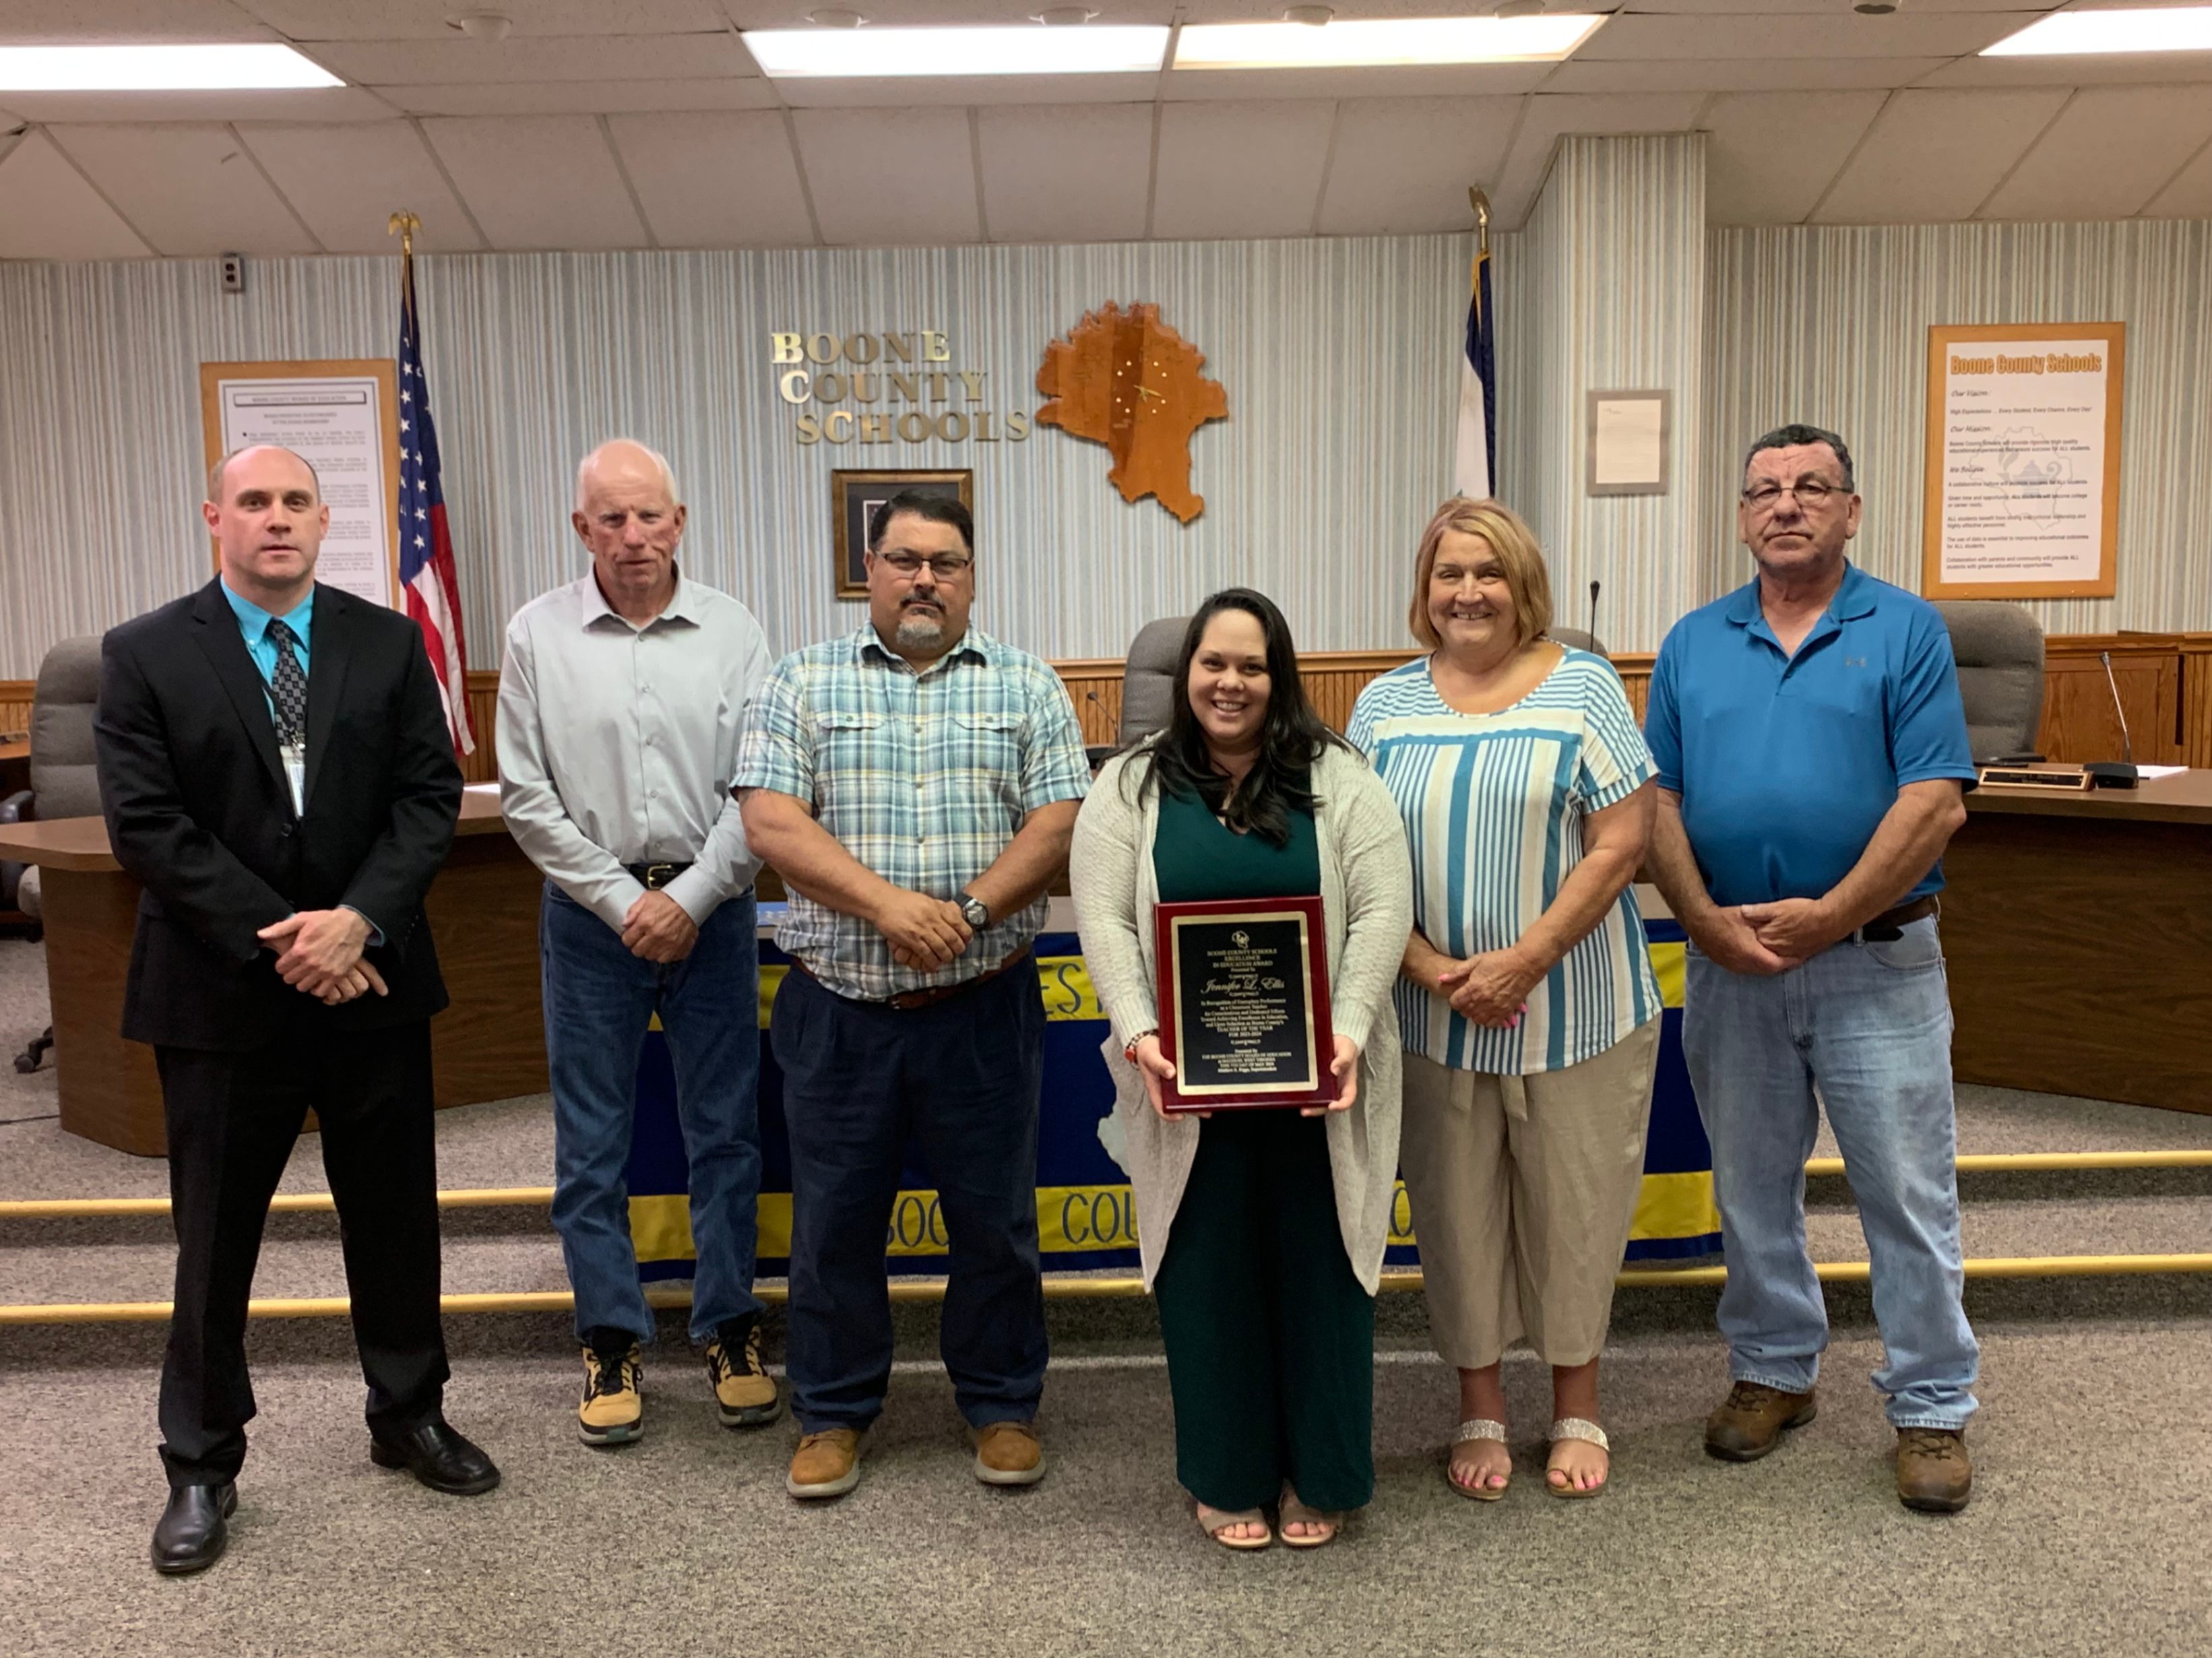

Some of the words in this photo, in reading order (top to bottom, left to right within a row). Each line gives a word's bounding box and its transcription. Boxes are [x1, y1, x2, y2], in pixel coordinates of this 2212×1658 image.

[771, 330, 950, 365] BOONE
[1951, 355, 1994, 374] Boone
[1997, 354, 2045, 374] County
[2047, 353, 2102, 373] Schools
[780, 369, 987, 404] COUNTY
[796, 410, 1030, 444] SCHOOLS
[1201, 978, 1241, 993] Jennifer
